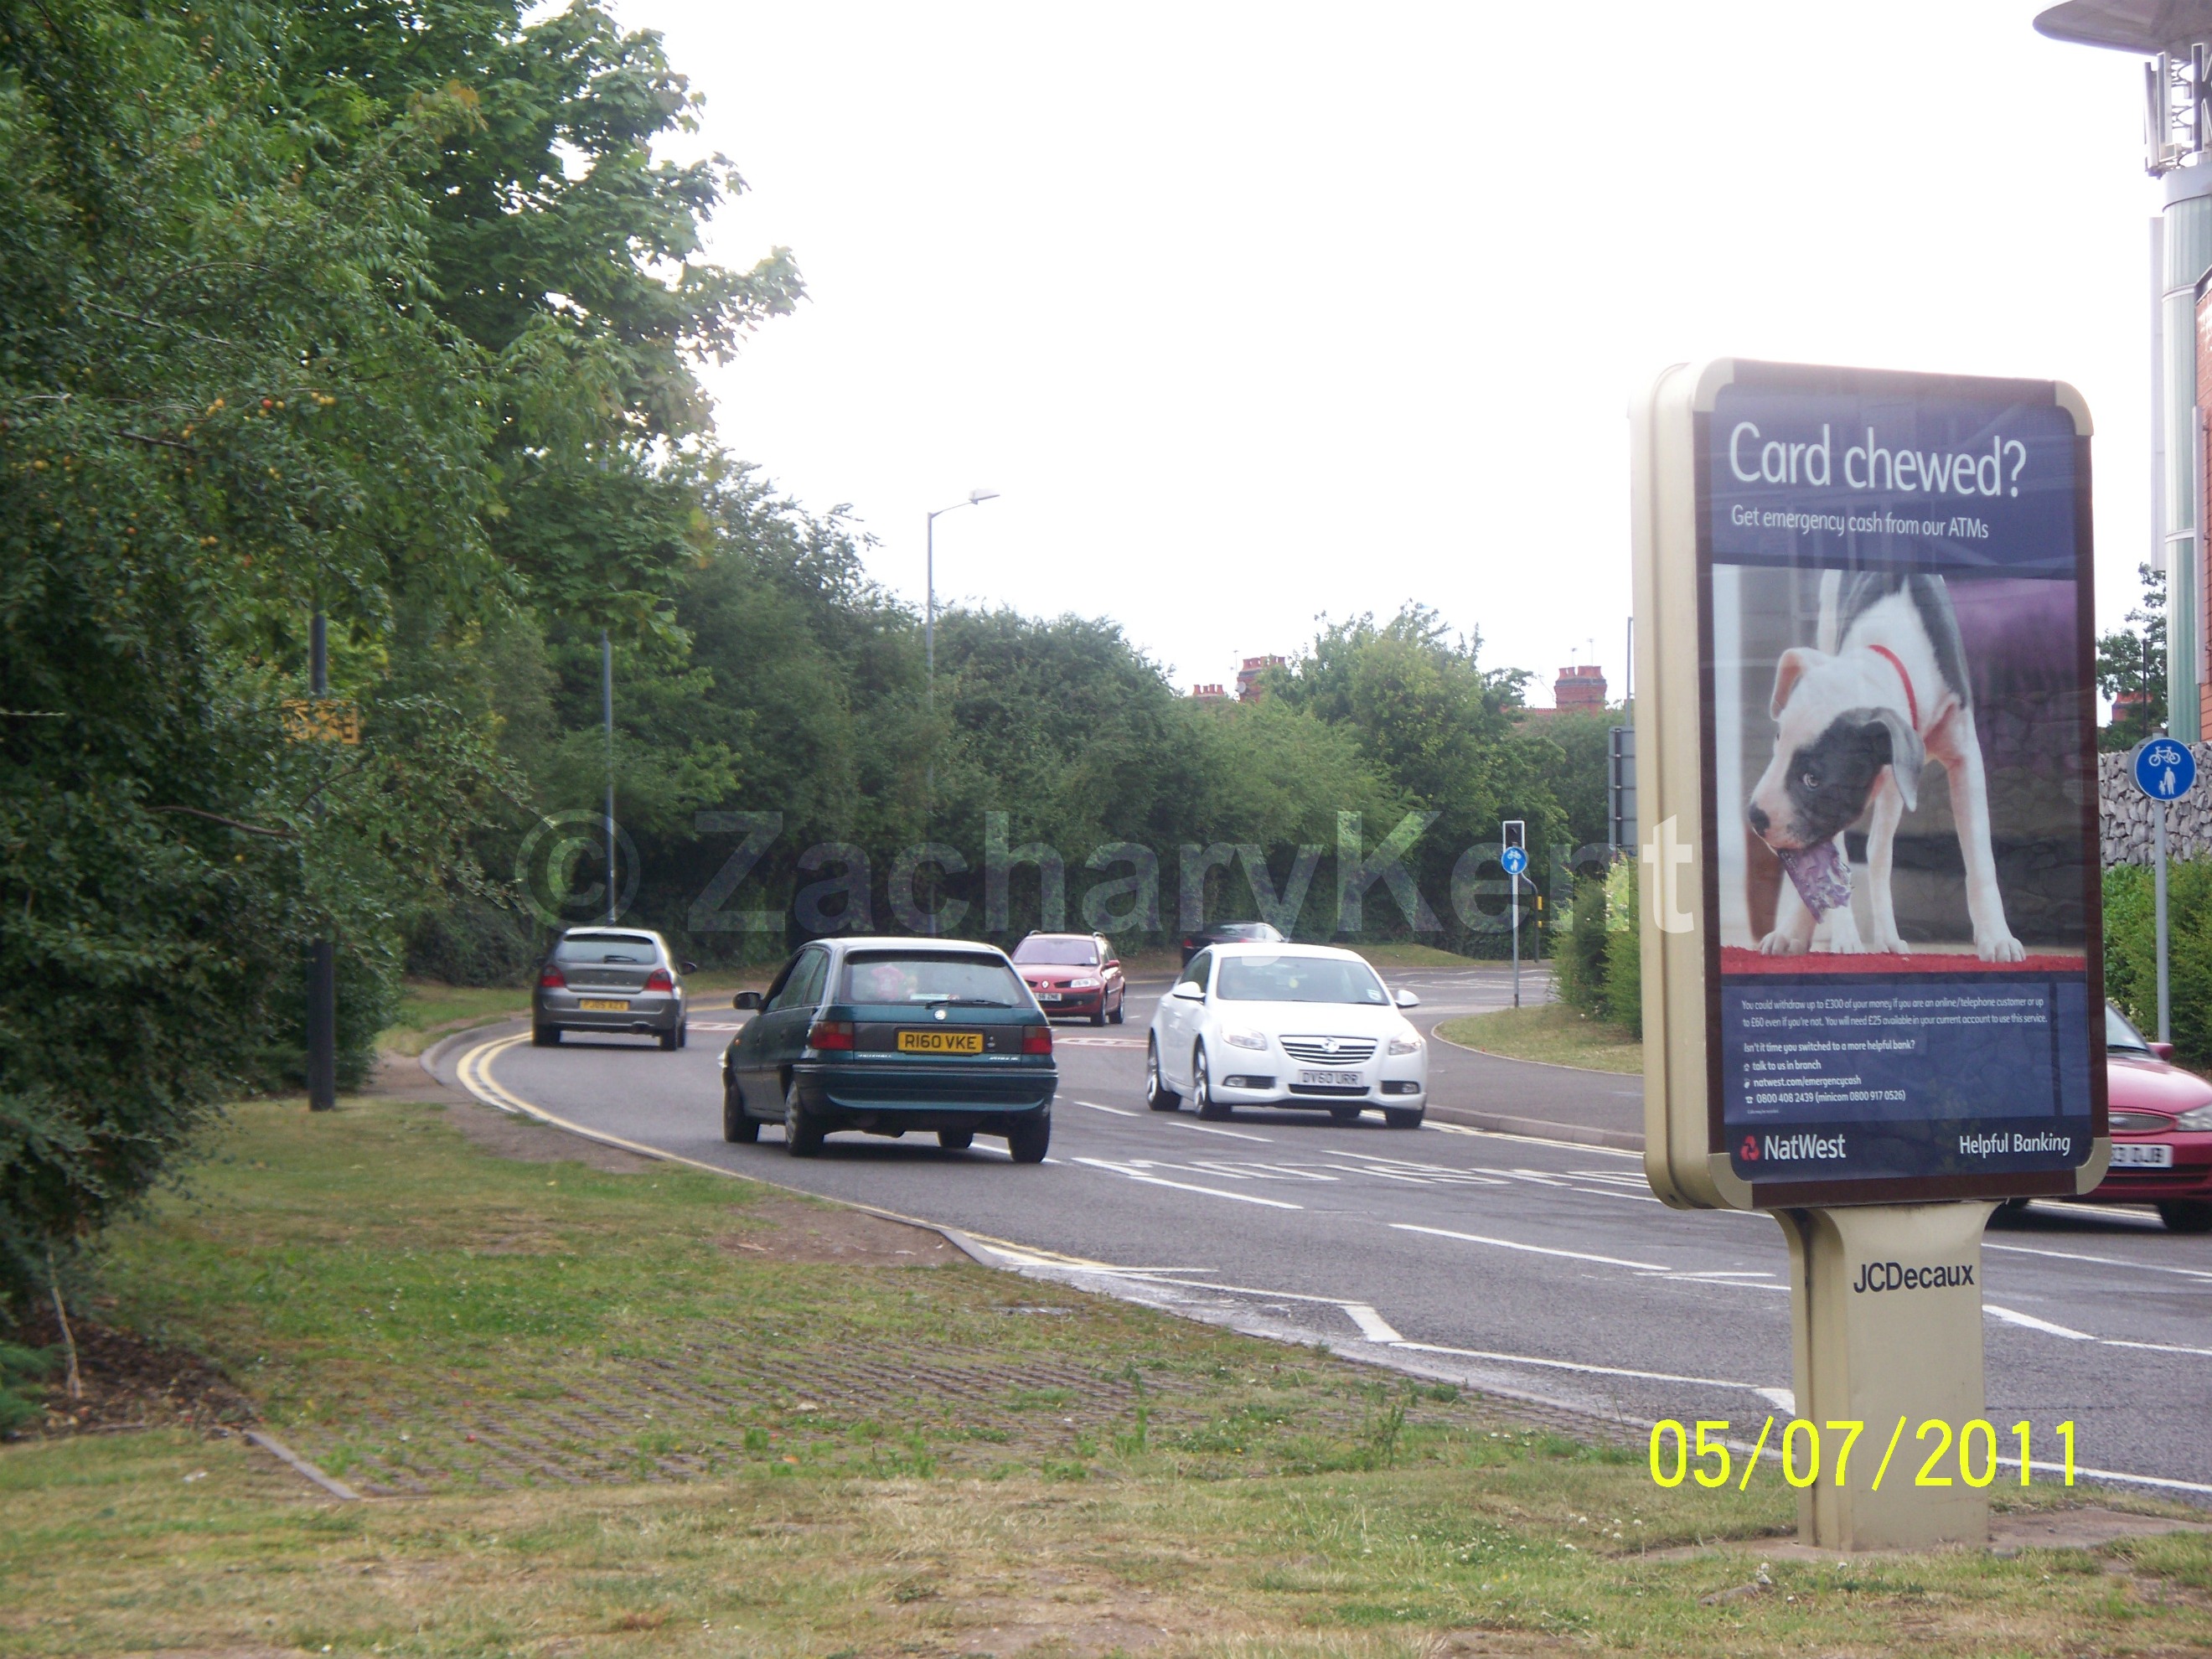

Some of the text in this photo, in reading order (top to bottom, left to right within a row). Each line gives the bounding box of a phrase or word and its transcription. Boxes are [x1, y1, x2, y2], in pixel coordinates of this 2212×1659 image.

[1729, 421, 2027, 497] Card chewed?
[1731, 504, 1989, 538] Get emergency cash from our ATMs
[1742, 1000, 1754, 1010] You
[1755, 1000, 1773, 1010] could
[1774, 1000, 1806, 1010] withdraw
[1807, 1001, 1815, 1011] up
[1817, 1000, 1824, 1009] to
[1825, 1000, 1843, 1009] £300
[1844, 998, 1852, 1008] of
[1853, 1000, 1868, 1010] your
[1869, 1000, 1892, 1010] money
[1893, 998, 1898, 1007] if
[1899, 1000, 1911, 1010] you
[1935, 997, 1995, 1009] online/telephone
[1997, 998, 2026, 1006] customer
[2035, 999, 2044, 1008] up
[1743, 1018, 1750, 1027] to
[1751, 1017, 1764, 1027] £60
[1765, 1018, 1781, 1026] even
[1782, 1016, 1787, 1026] if
[1788, 1017, 1809, 1029] you're
[1810, 1017, 1824, 1026] not.
[1825, 1016, 1837, 1026] You
[1838, 1016, 1850, 1026] will
[1850, 1016, 1867, 1026] need
[1868, 1016, 1881, 1026] £25
[1883, 1015, 1912, 1025] available
[1913, 1015, 1919, 1024] in
[1920, 1016, 1935, 1026] your
[1936, 1016, 1961, 1024] current
[1961, 1015, 1991, 1024] account
[1992, 1015, 1998, 1023] to
[2011, 1013, 2023, 1022] this
[2023, 1014, 2048, 1023] service.
[904, 1034, 977, 1050] R160 VKE
[1744, 1043, 1759, 1052] Isn't
[1760, 1042, 1765, 1052] it
[1765, 1042, 1782, 1052] time
[1784, 1044, 1797, 1054] you
[1798, 1041, 1831, 1052] switched
[1832, 1041, 1840, 1051] to
[1867, 1040, 1892, 1052] helpful
[1893, 1040, 1915, 1050] bank?
[1752, 1060, 1766, 1071] talk
[1767, 1062, 1775, 1070] to
[1786, 1060, 1794, 1070] in
[1795, 1059, 1822, 1070] branch
[1336, 1073, 1357, 1084] URR
[1754, 1075, 1862, 1088] natwest.com/emergencycash
[1756, 1090, 1906, 1103] 0800 408 2439 (minicom 0800 917 0526)
[1765, 1134, 1846, 1160] NatWest
[1960, 1131, 2070, 1159] Helpful Banking
[1853, 1262, 1975, 1294] JCDecaux
